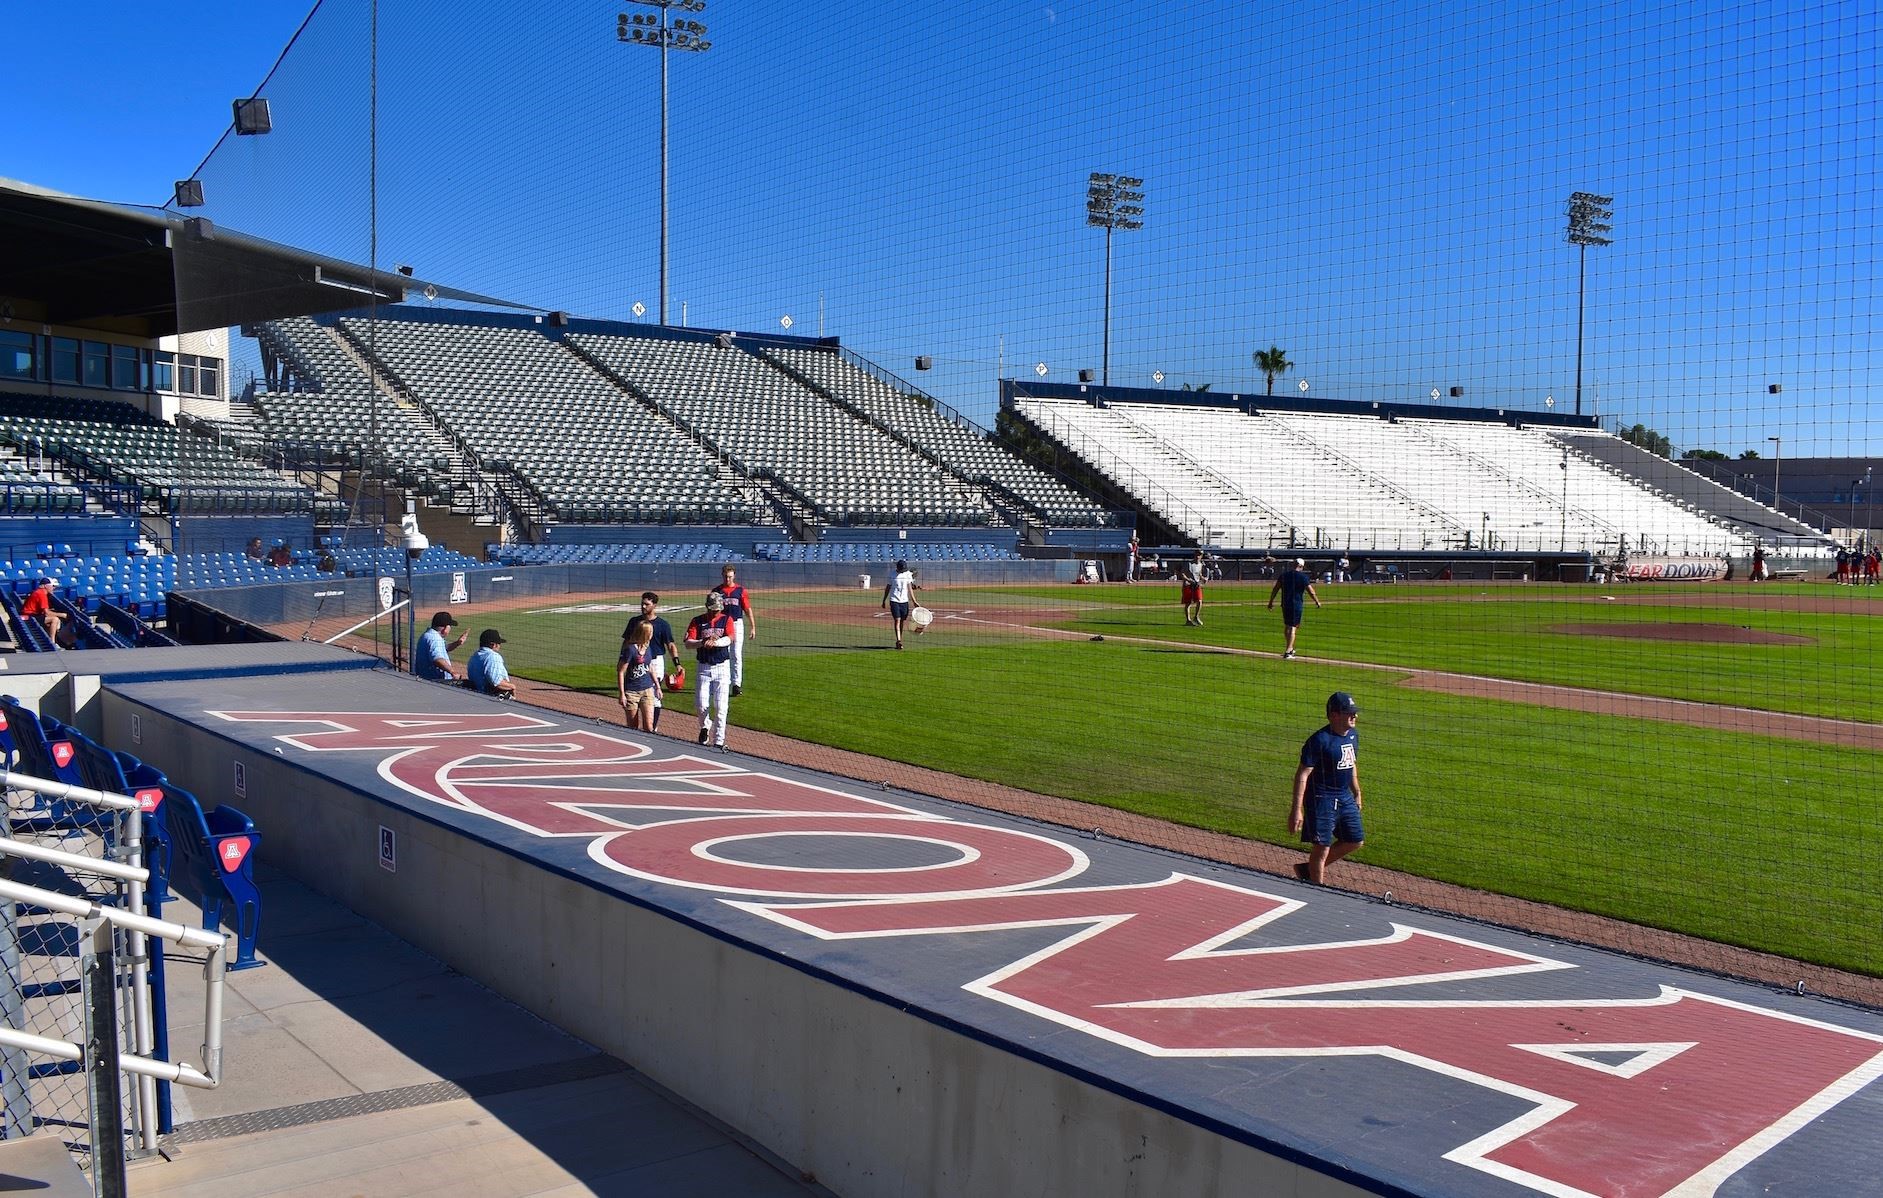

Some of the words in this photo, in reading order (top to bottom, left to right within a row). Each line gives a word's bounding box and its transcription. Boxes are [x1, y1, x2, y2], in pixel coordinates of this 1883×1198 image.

[1627, 563, 1663, 578] EAR
[1664, 562, 1720, 578] DOWN
[450, 572, 467, 604] A
[1337, 743, 1356, 770] A
[140, 793, 155, 807] A
[225, 843, 241, 859] A
[204, 710, 1883, 1198] ARIZONA
